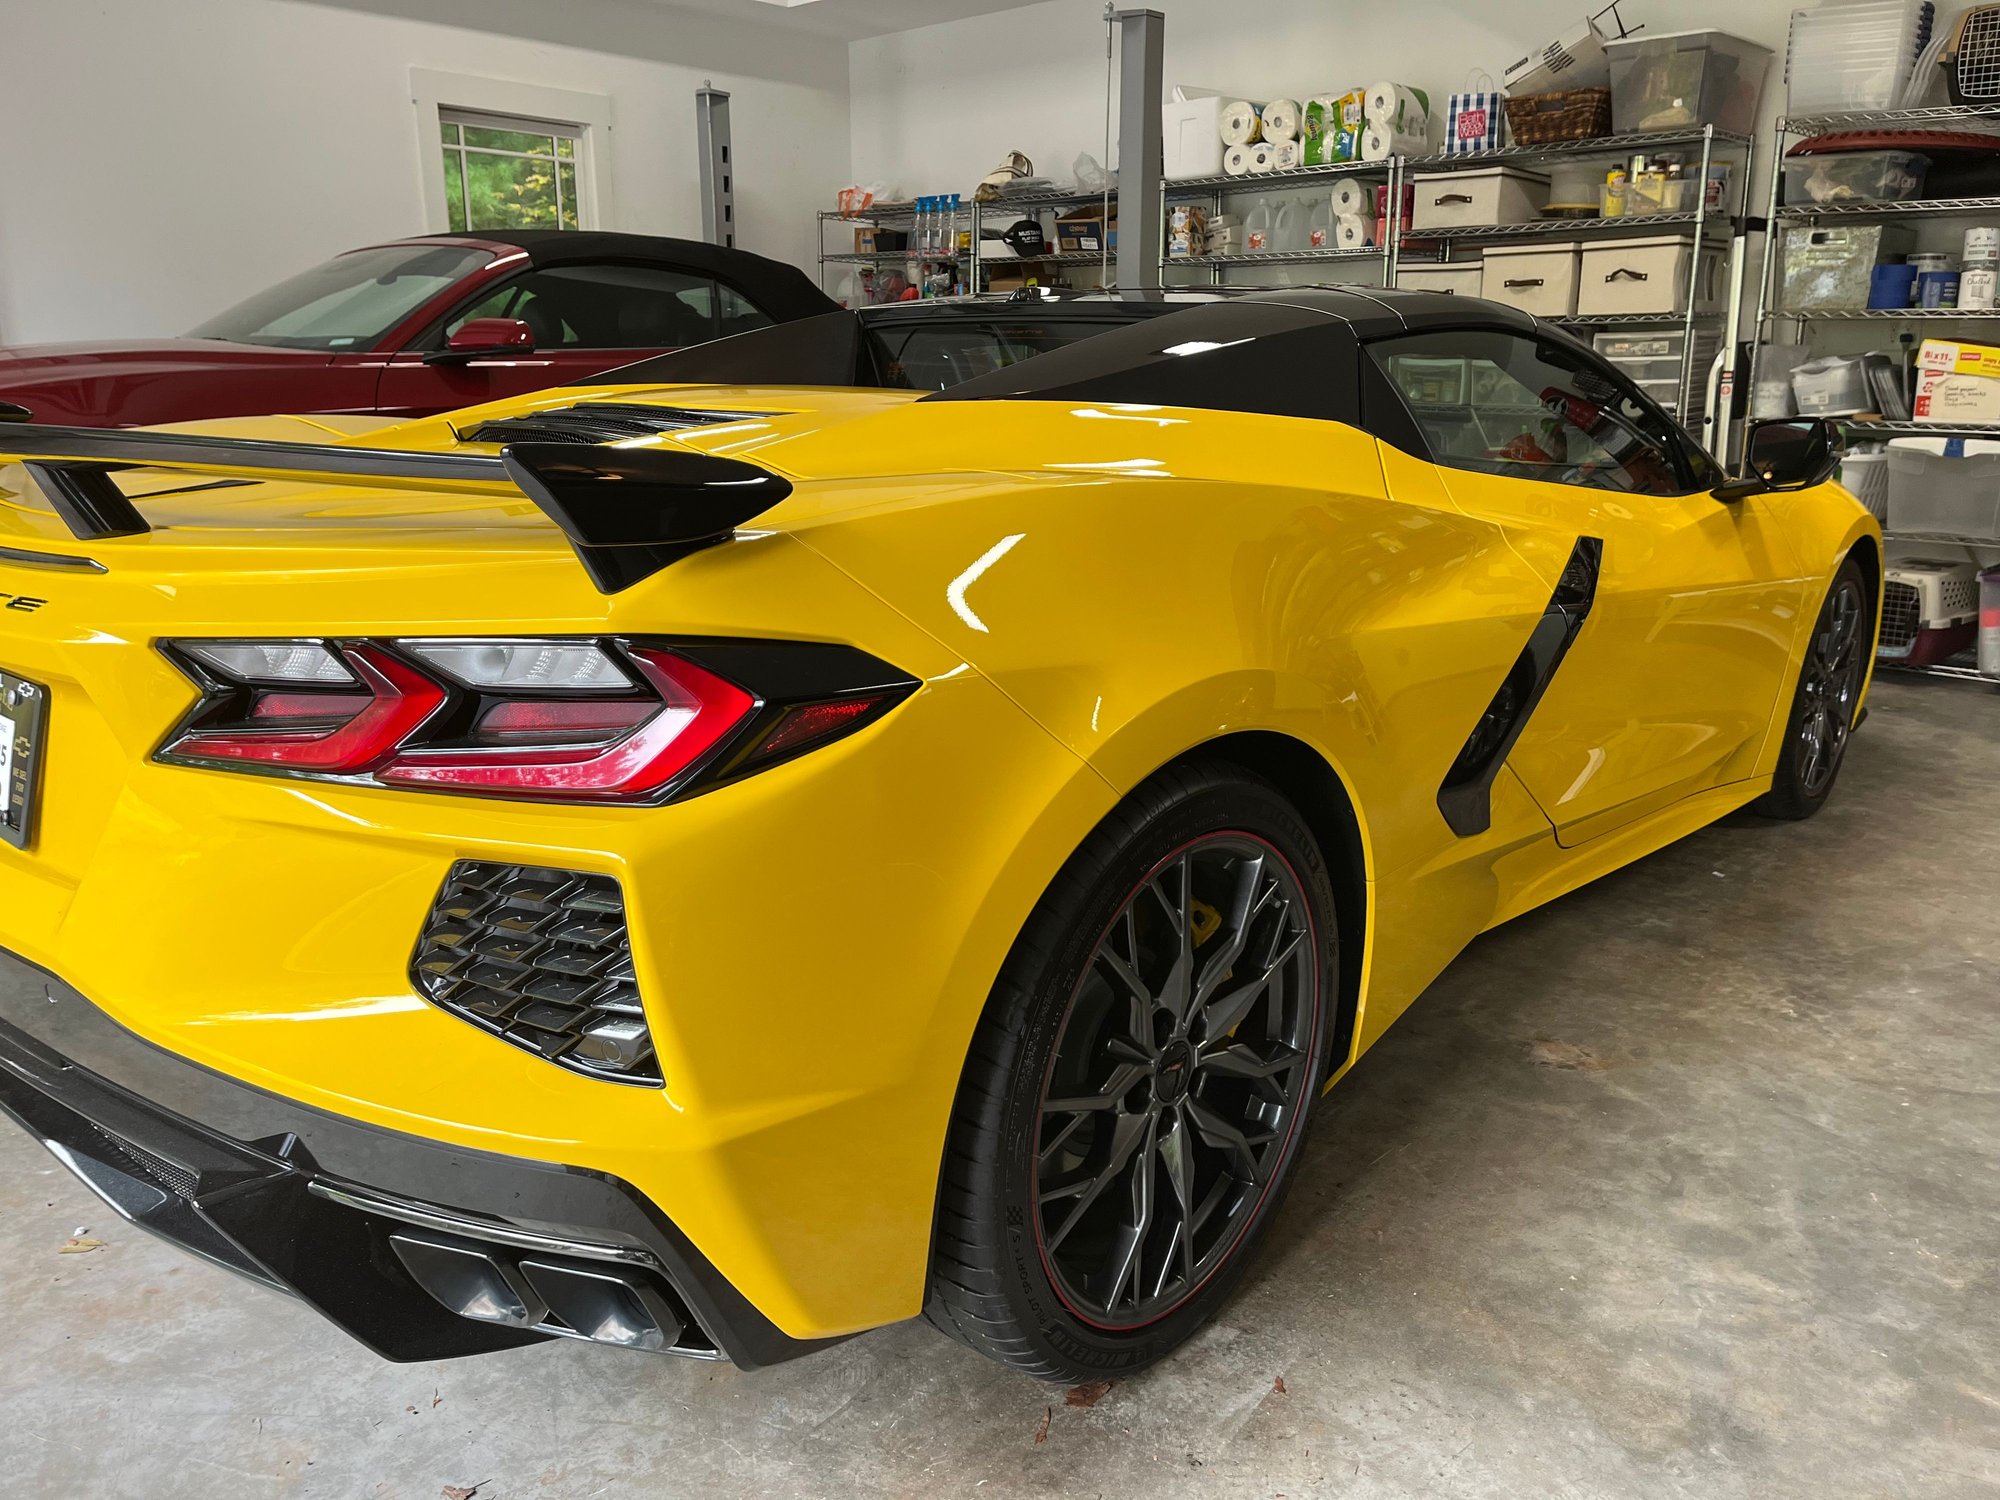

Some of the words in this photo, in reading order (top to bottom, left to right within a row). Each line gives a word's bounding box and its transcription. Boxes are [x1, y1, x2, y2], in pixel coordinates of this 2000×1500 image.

[1460, 112, 1484, 124] Bath
[1014, 1255, 1034, 1294] SPORT
[1048, 1328, 1131, 1367] MICHELIN
